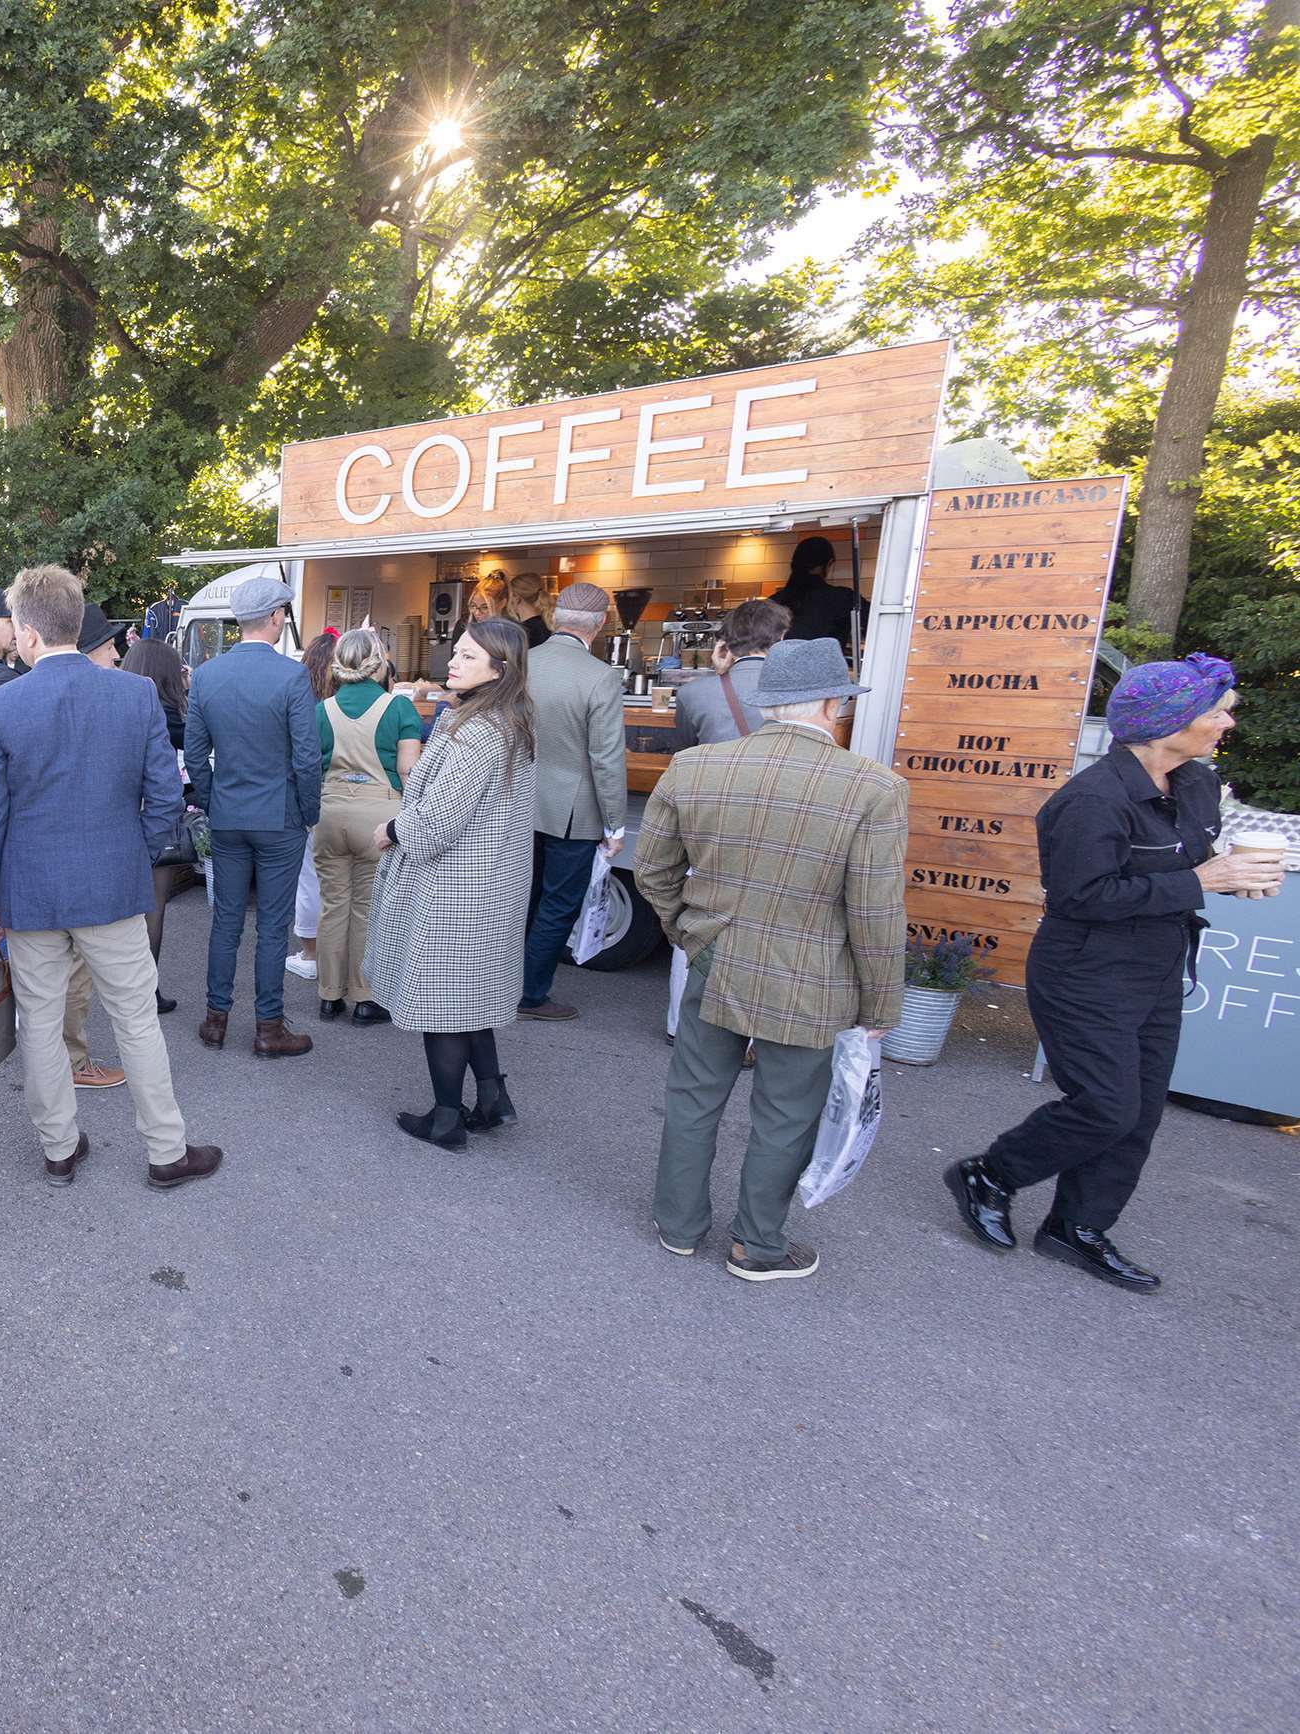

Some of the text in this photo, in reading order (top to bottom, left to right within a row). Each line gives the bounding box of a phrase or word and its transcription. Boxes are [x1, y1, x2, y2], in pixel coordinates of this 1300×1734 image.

[336, 379, 817, 525] COFFEE
[943, 484, 1108, 513] AMERICANO
[969, 551, 1057, 571] LATTE
[922, 613, 1090, 631] CAPPUCCINO
[946, 673, 1040, 691] MOCHA
[957, 734, 1011, 752] HOT
[906, 754, 1058, 780] CHOCOLATE
[938, 815, 1004, 836] TEAS
[911, 868, 1012, 895] SYRUPS
[1195, 928, 1300, 977] RE
